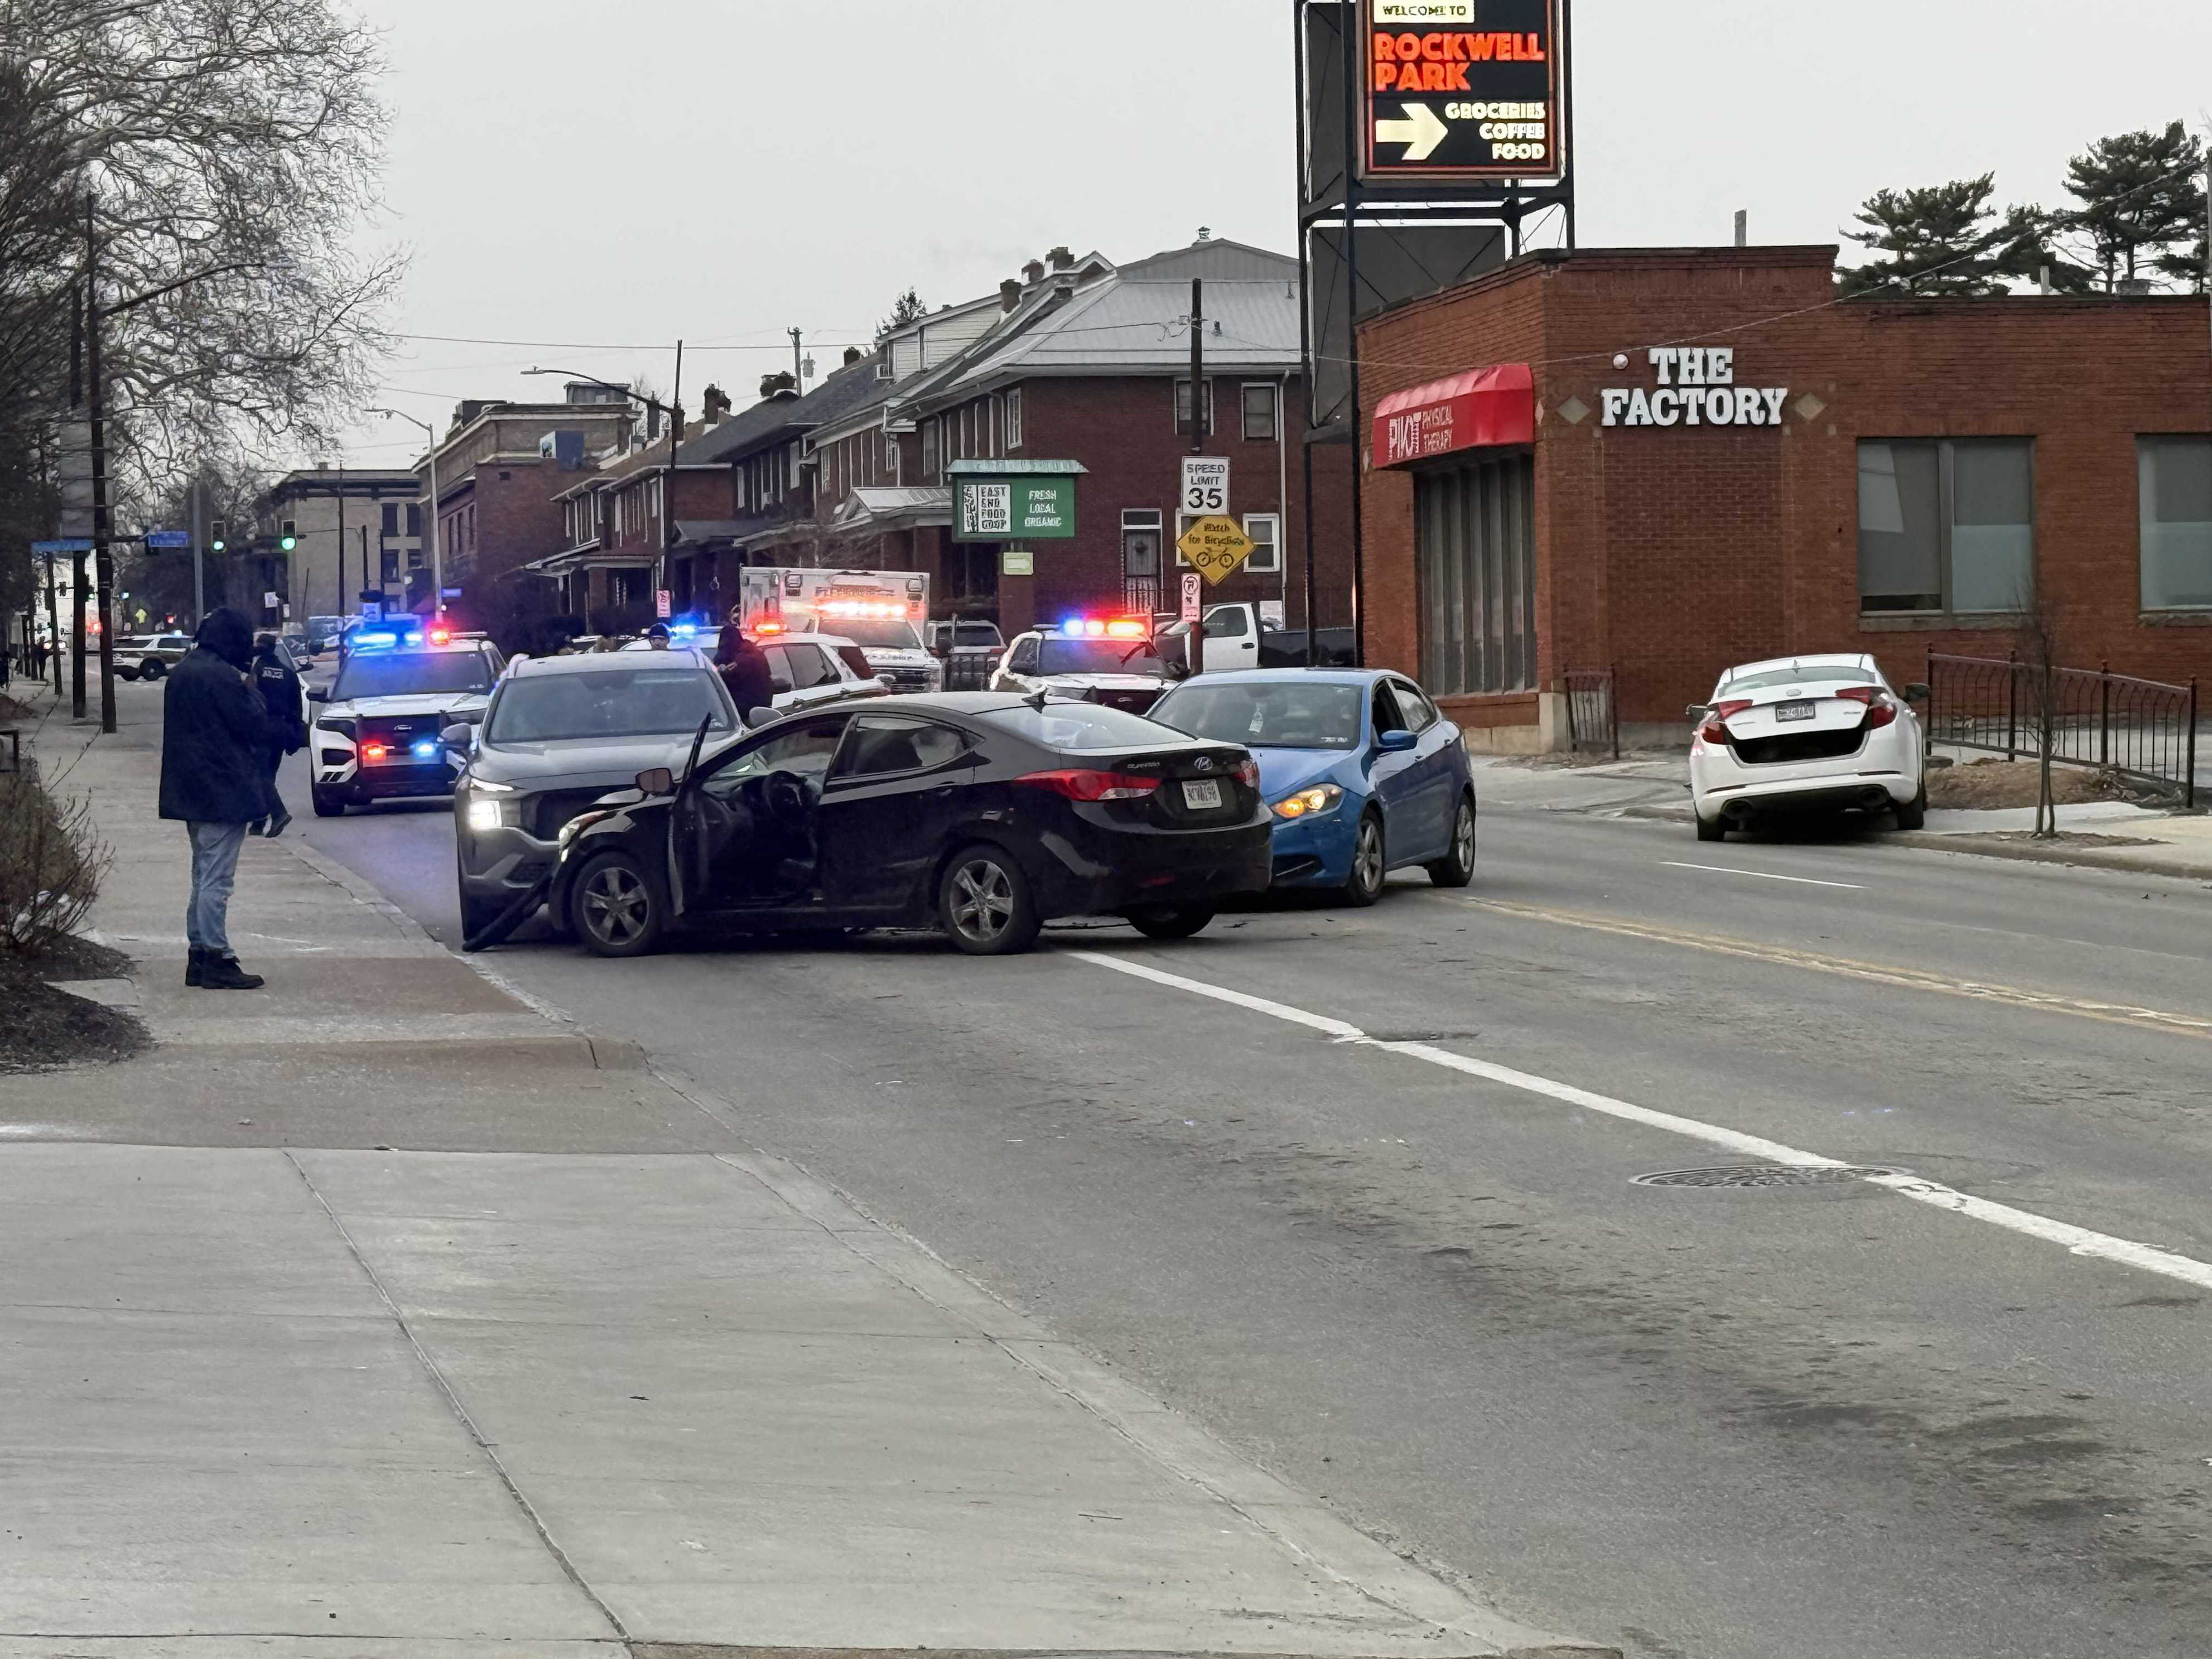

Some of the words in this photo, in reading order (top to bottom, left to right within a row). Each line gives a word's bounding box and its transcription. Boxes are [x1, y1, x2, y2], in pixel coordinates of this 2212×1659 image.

[1449, 6, 1466, 16] TO
[1375, 32, 1545, 61] ROCKWELL
[1375, 62, 1471, 91] PARK
[1445, 102, 1545, 119] GROCERIES
[1479, 123, 1545, 139] COFFEE
[1492, 143, 1545, 160] FOOD
[1649, 347, 1733, 385] THE
[1601, 388, 1787, 427] FACTORY
[1187, 464, 1225, 473] SPEED
[1191, 476, 1220, 485] LIMIT
[981, 487, 1006, 497] EAST
[1029, 490, 1056, 500] FRESH
[1188, 488, 1223, 509] 35
[981, 498, 1000, 508] END
[1030, 503, 1056, 513] LOCAL
